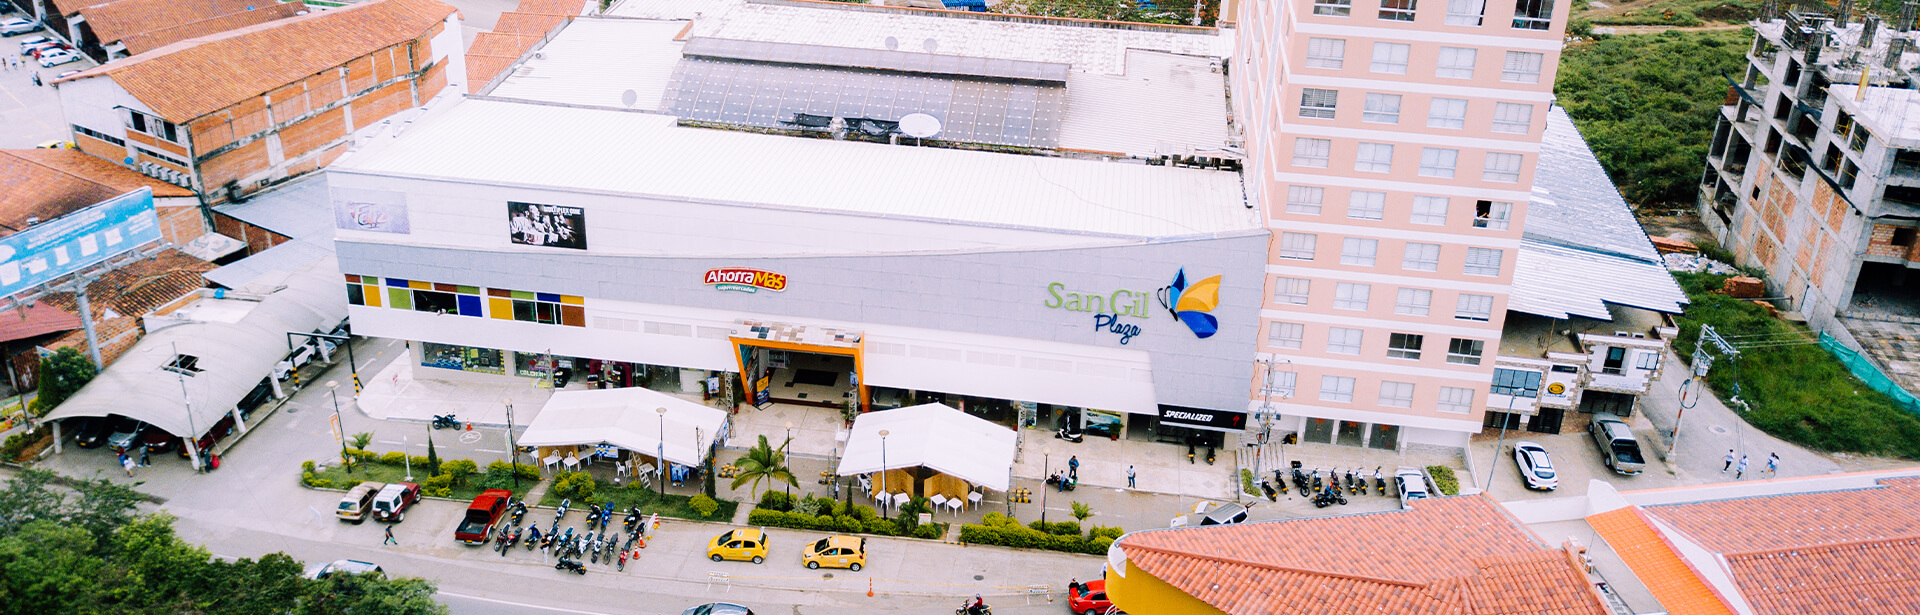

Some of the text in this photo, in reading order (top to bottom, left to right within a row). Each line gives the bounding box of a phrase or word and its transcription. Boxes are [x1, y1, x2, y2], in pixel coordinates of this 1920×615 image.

[1045, 282, 1150, 319] San Gil
[1094, 313, 1142, 345] Plaza
[1163, 410, 1214, 423] SPECIALIZED
